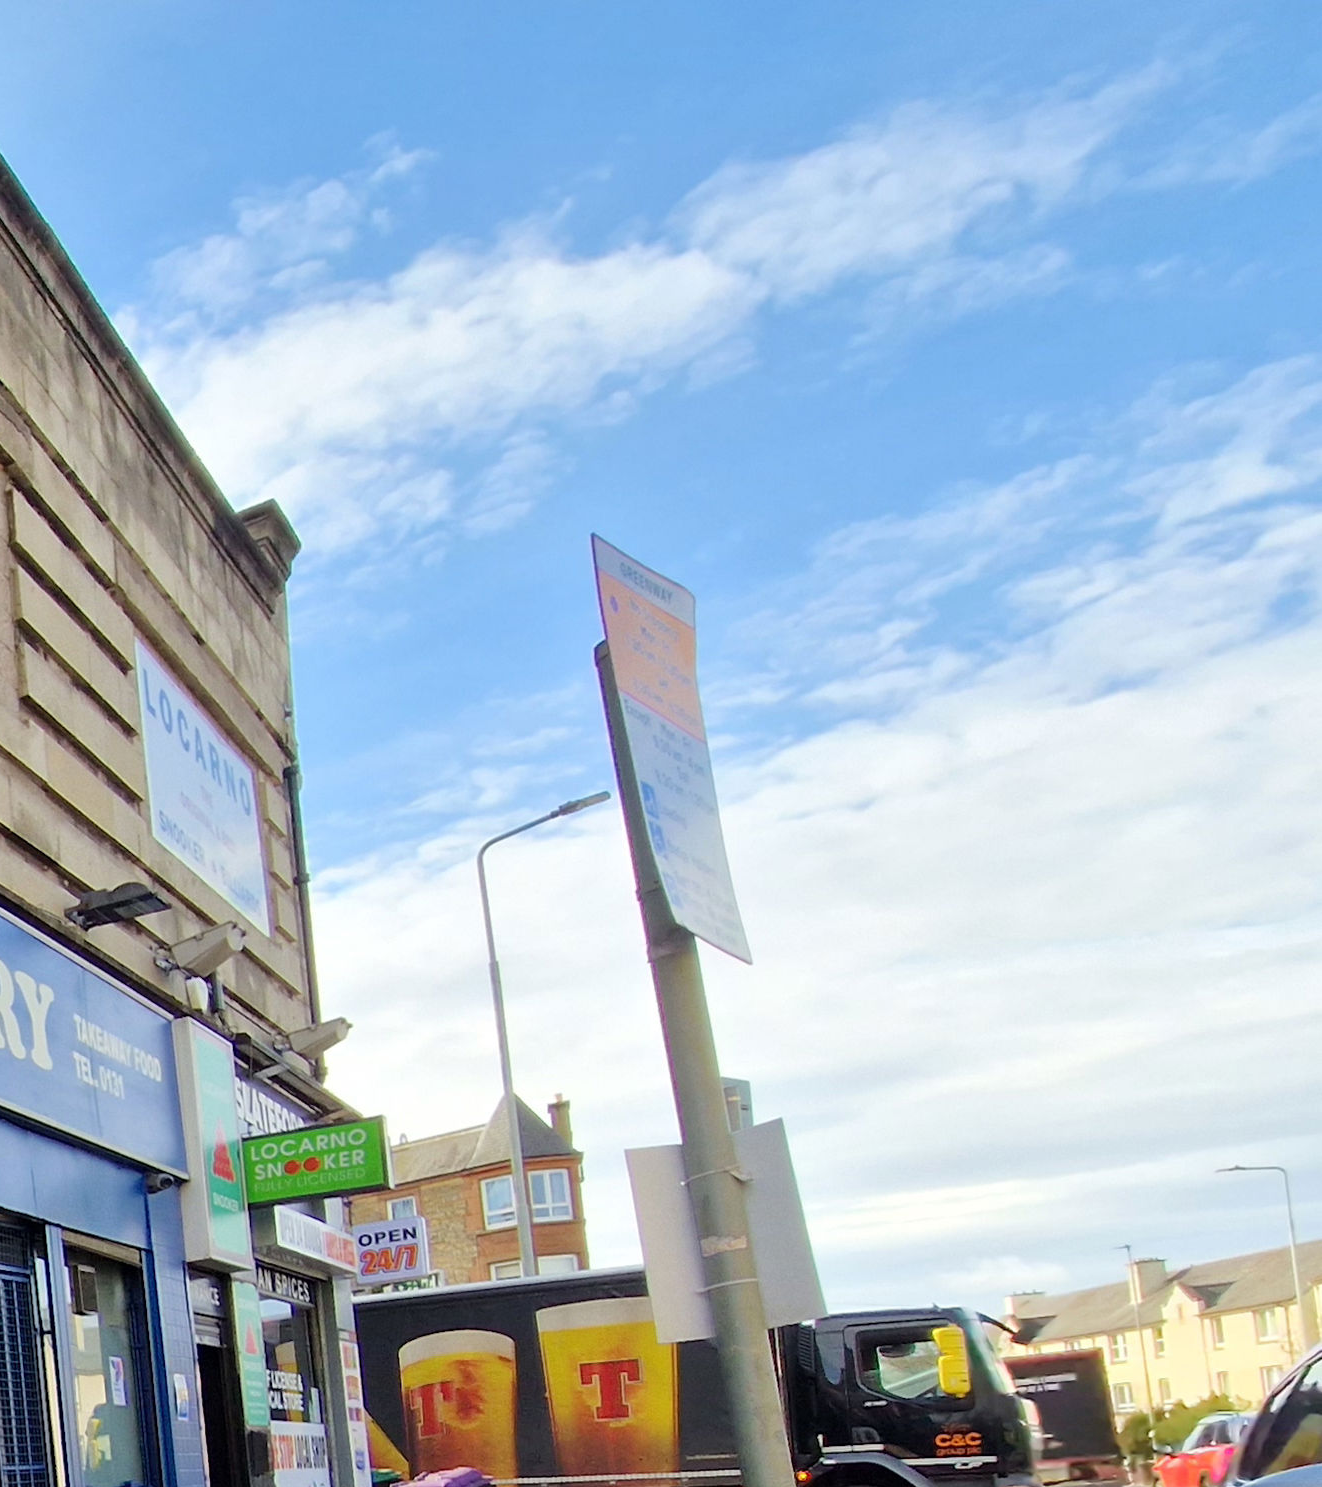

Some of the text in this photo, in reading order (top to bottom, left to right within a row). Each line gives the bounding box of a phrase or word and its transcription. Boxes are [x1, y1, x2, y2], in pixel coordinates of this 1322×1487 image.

[142, 667, 252, 817] LOCARNO
[72, 1013, 162, 1082] TAKEAWAY FOOD
[72, 1051, 99, 1088] TEL.
[250, 1128, 368, 1161] LOCARNO
[358, 1226, 418, 1247] OPEN
[359, 1244, 420, 1277] 24/7
[274, 1273, 311, 1303] SPICES
[578, 1357, 642, 1423] T
[934, 1431, 983, 1448] C&C
